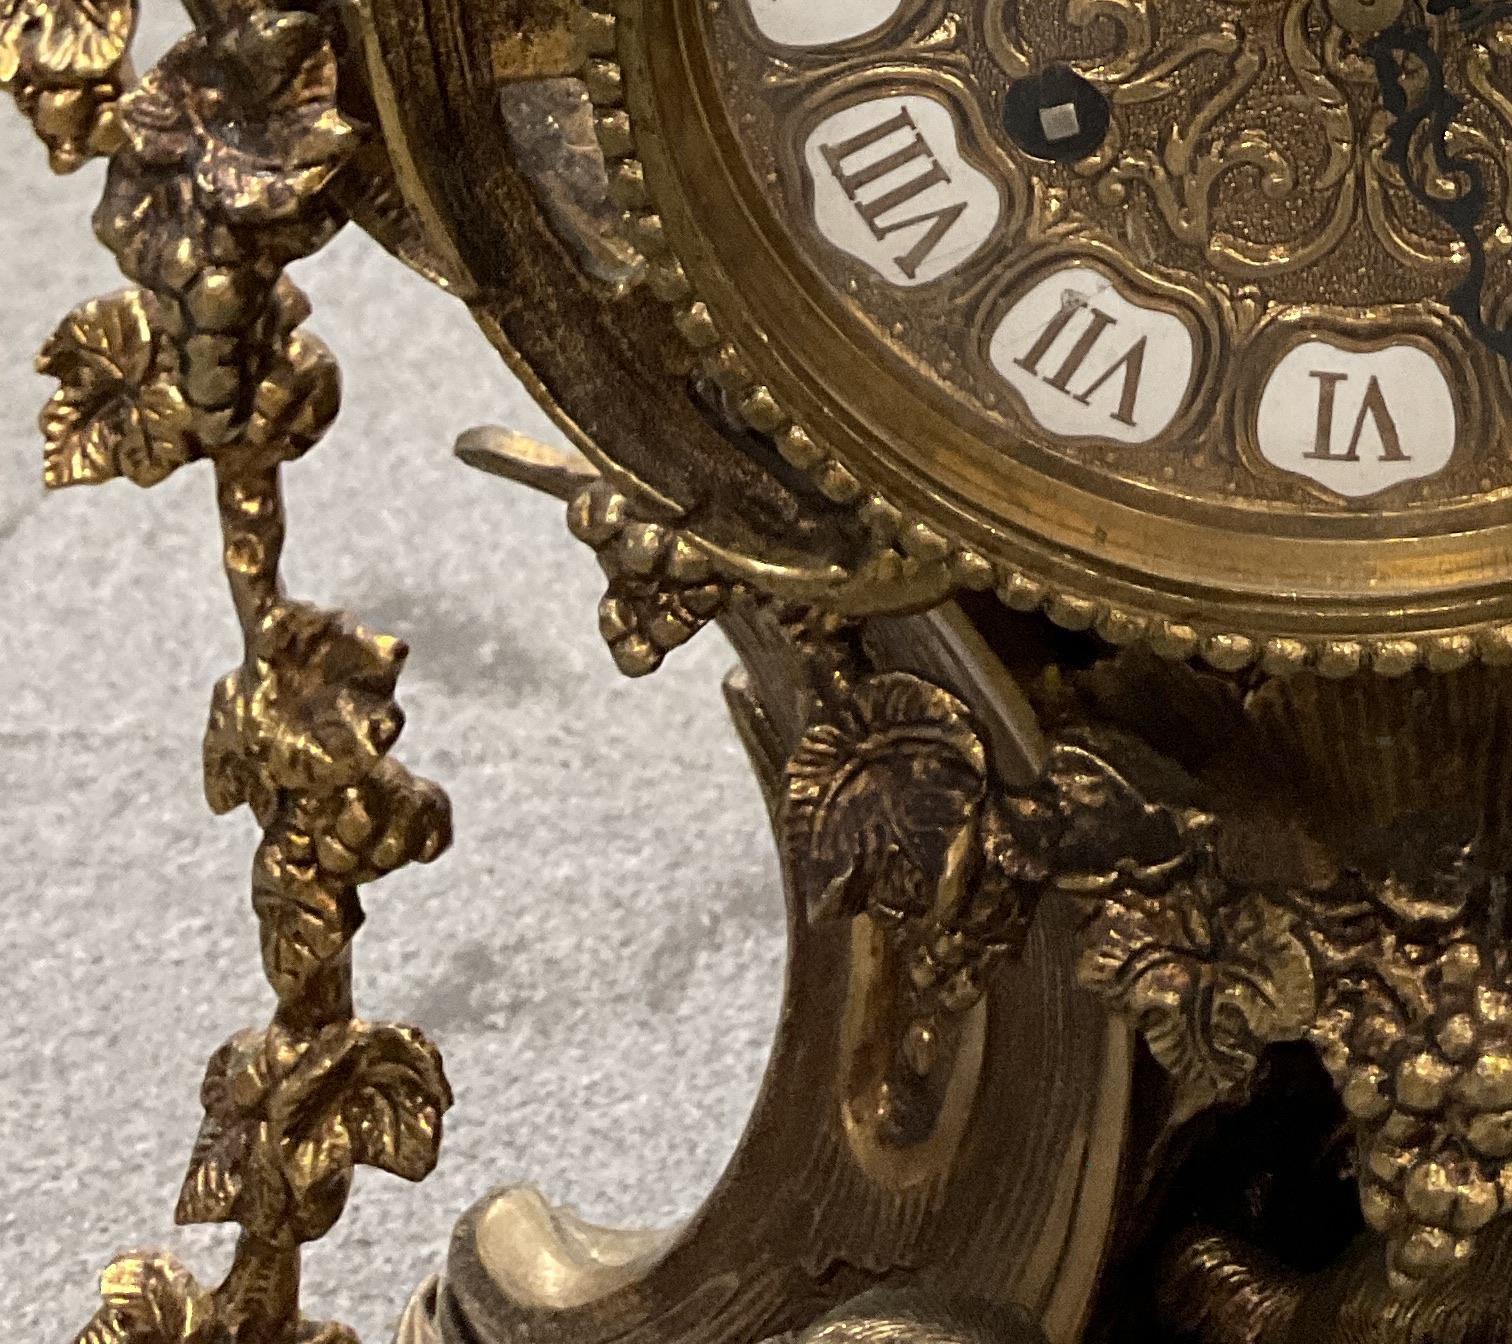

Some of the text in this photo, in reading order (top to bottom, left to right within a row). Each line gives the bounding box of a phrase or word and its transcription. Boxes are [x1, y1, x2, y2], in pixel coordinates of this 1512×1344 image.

[817, 105, 969, 277] VIII
[1013, 302, 1146, 427] VII
[1303, 371, 1412, 462] VI
